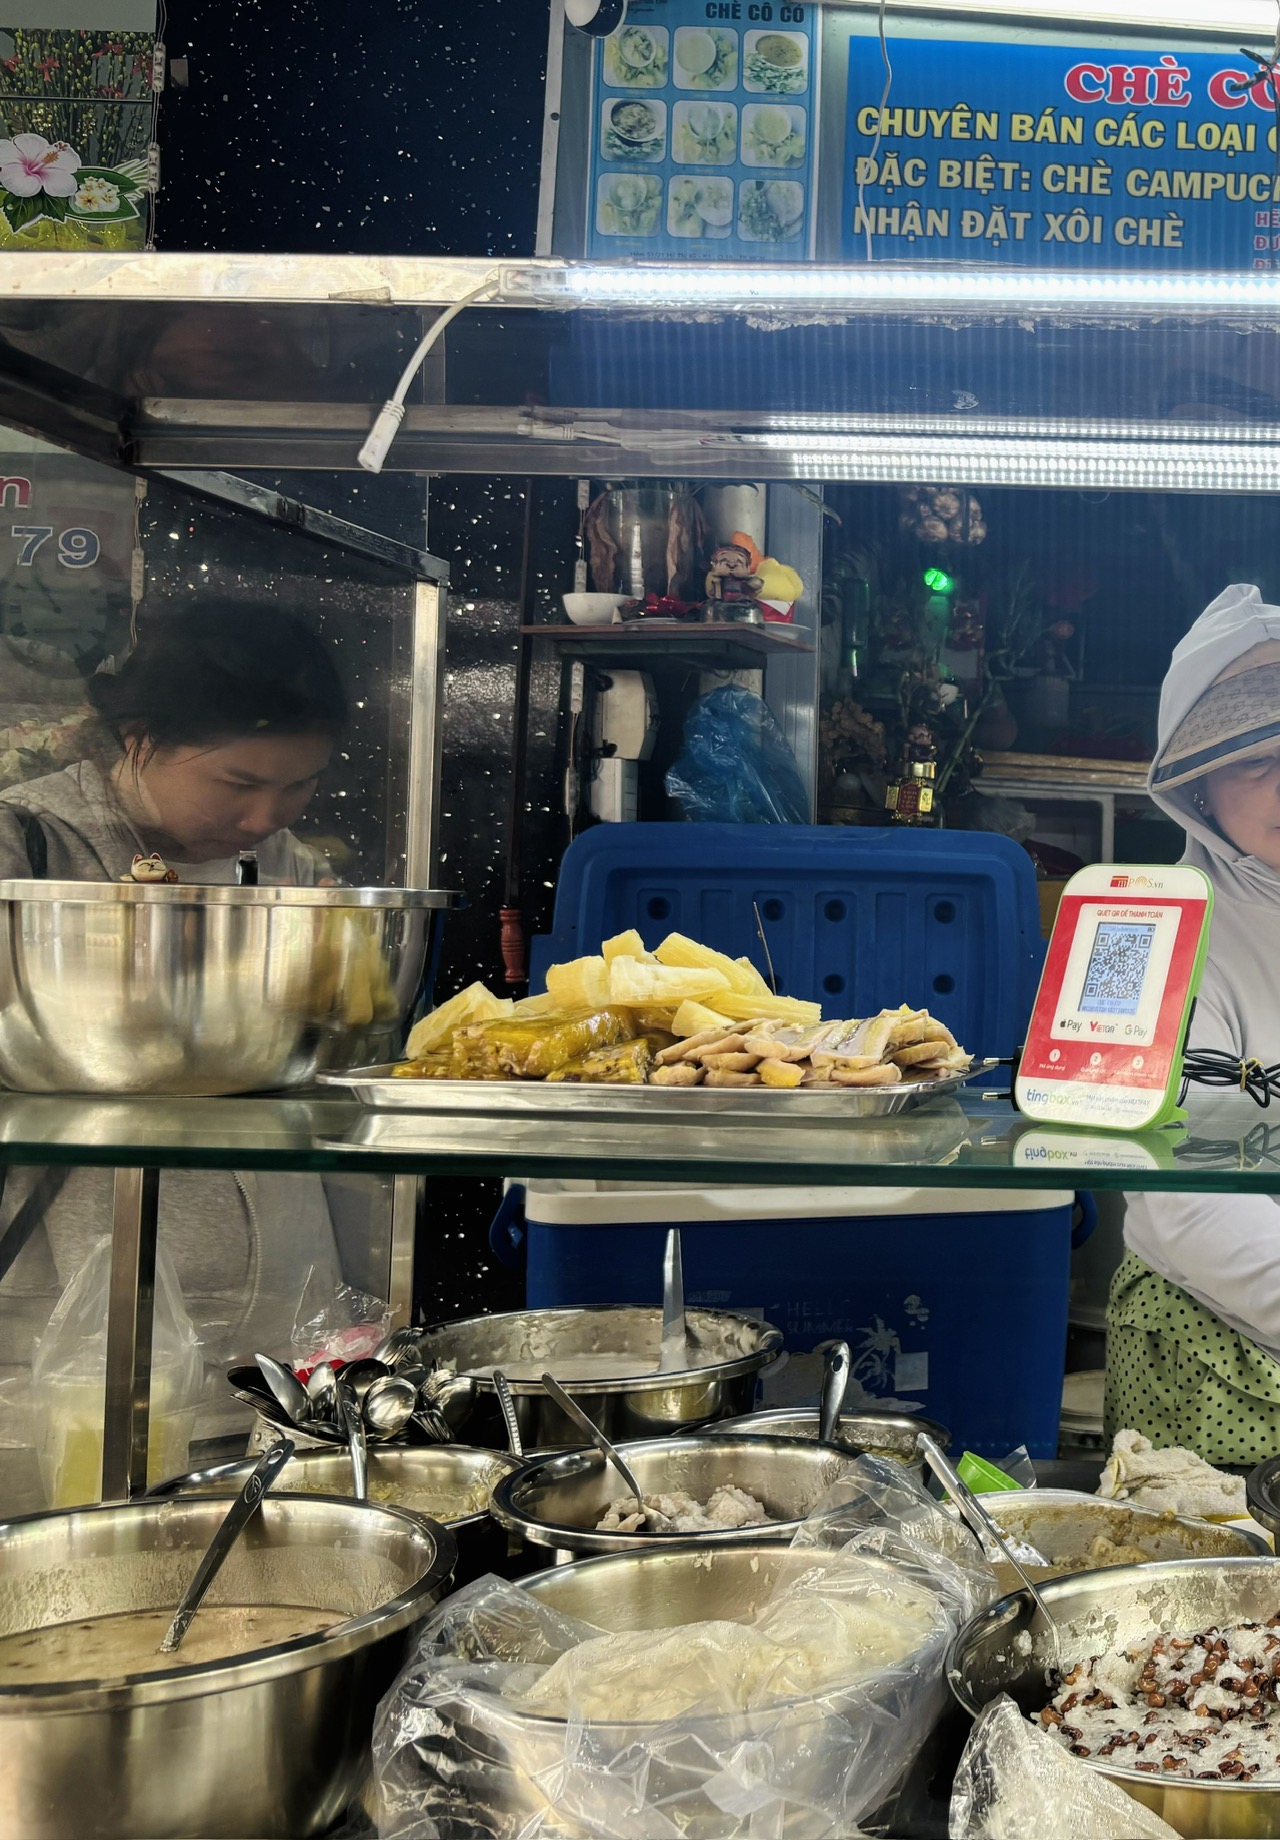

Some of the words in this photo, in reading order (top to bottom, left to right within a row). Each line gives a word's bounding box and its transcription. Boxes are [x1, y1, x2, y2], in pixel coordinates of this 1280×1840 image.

[705, 0, 741, 20] CHÈ
[748, 1, 773, 22] CÔ
[780, 4, 805, 23] CÓ
[1064, 56, 1192, 108] CHÈ
[856, 102, 1000, 141] CHUYÊN
[1009, 105, 1084, 146] BÁN
[1094, 109, 1166, 149] CÁC
[1176, 119, 1257, 158] LOẠI
[854, 151, 927, 196] ĐẶC
[938, 153, 1033, 196] BIỆT:
[1041, 156, 1113, 196] CHÈ
[853, 200, 950, 243] NHẬN
[960, 203, 1033, 248] ĐẶT
[1042, 206, 1103, 245] XÔI
[1113, 210, 1186, 250] CHÈ
[11, 525, 101, 569] 79
[1067, 1019, 1082, 1032] Pay
[1133, 1025, 1147, 1038] Pay
